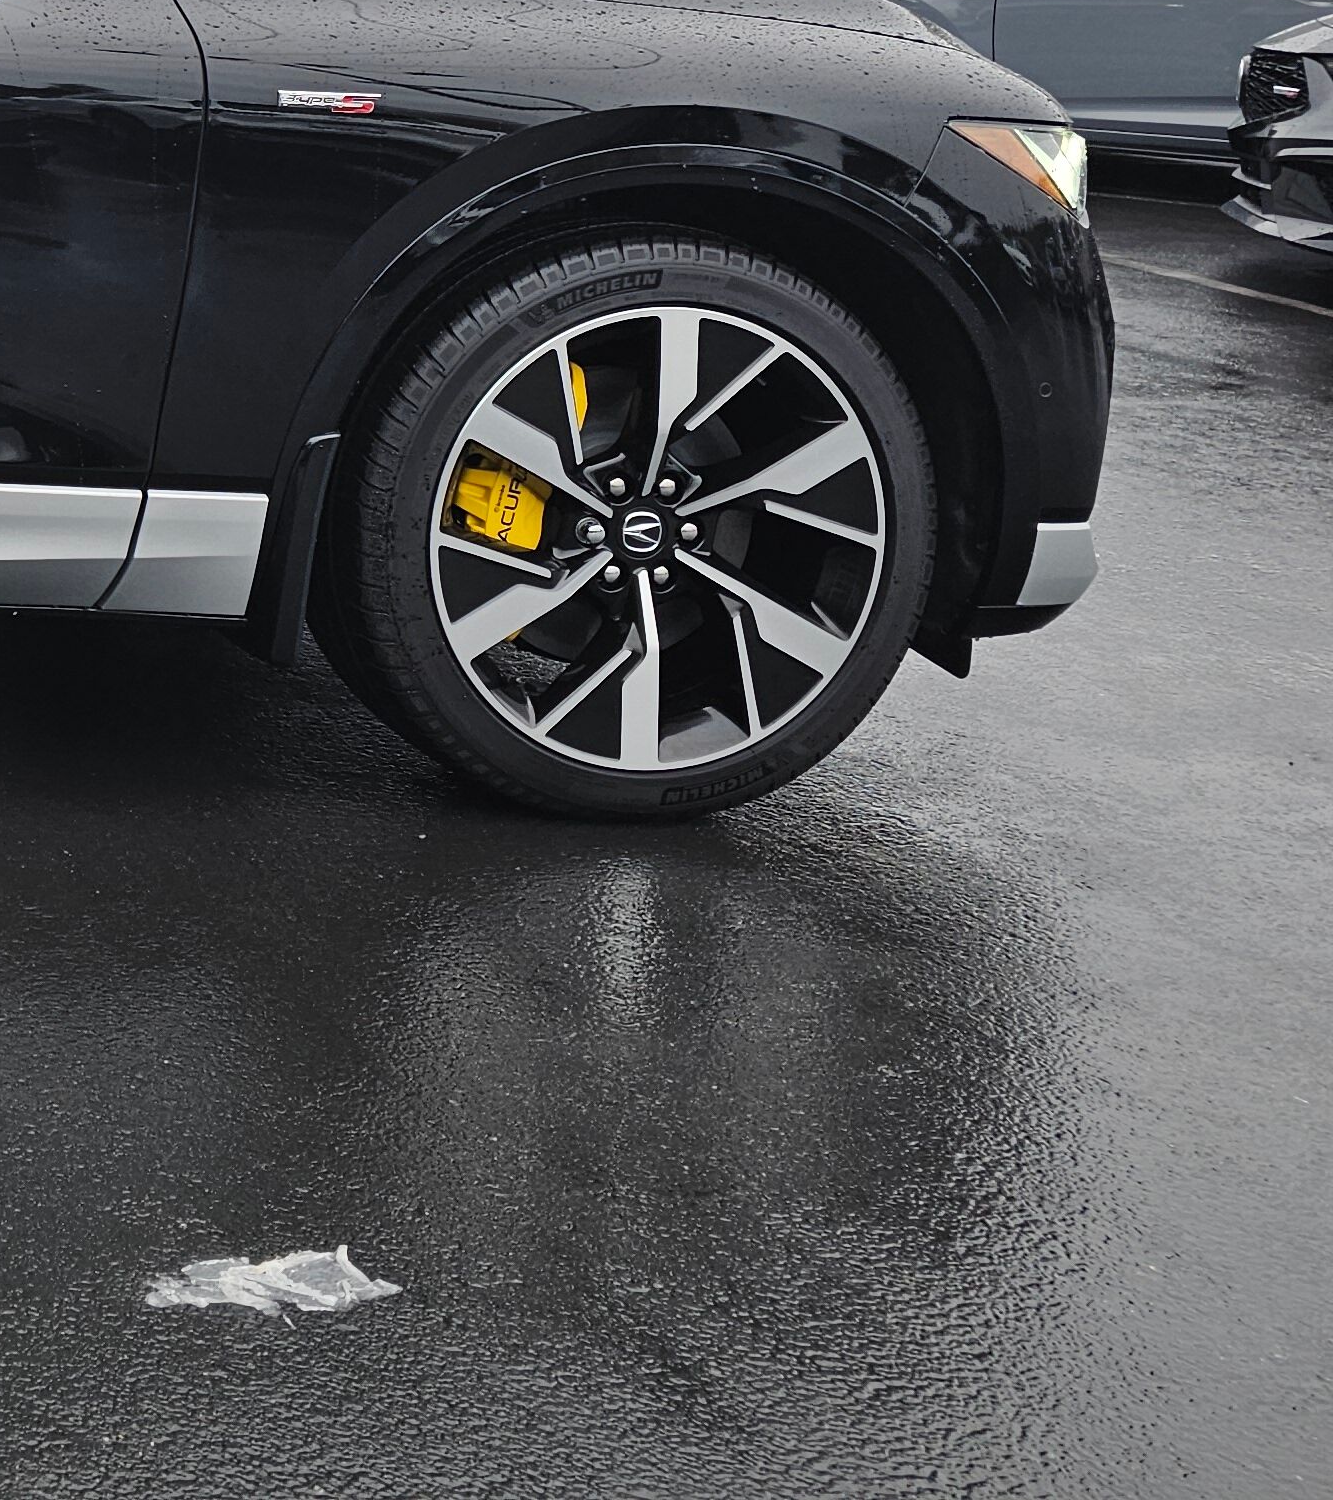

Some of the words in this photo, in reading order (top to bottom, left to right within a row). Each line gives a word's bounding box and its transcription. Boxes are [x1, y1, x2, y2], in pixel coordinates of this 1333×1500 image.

[331, 94, 382, 114] S
[557, 273, 658, 309] MICHELIN
[667, 767, 764, 804] MICHELIN
